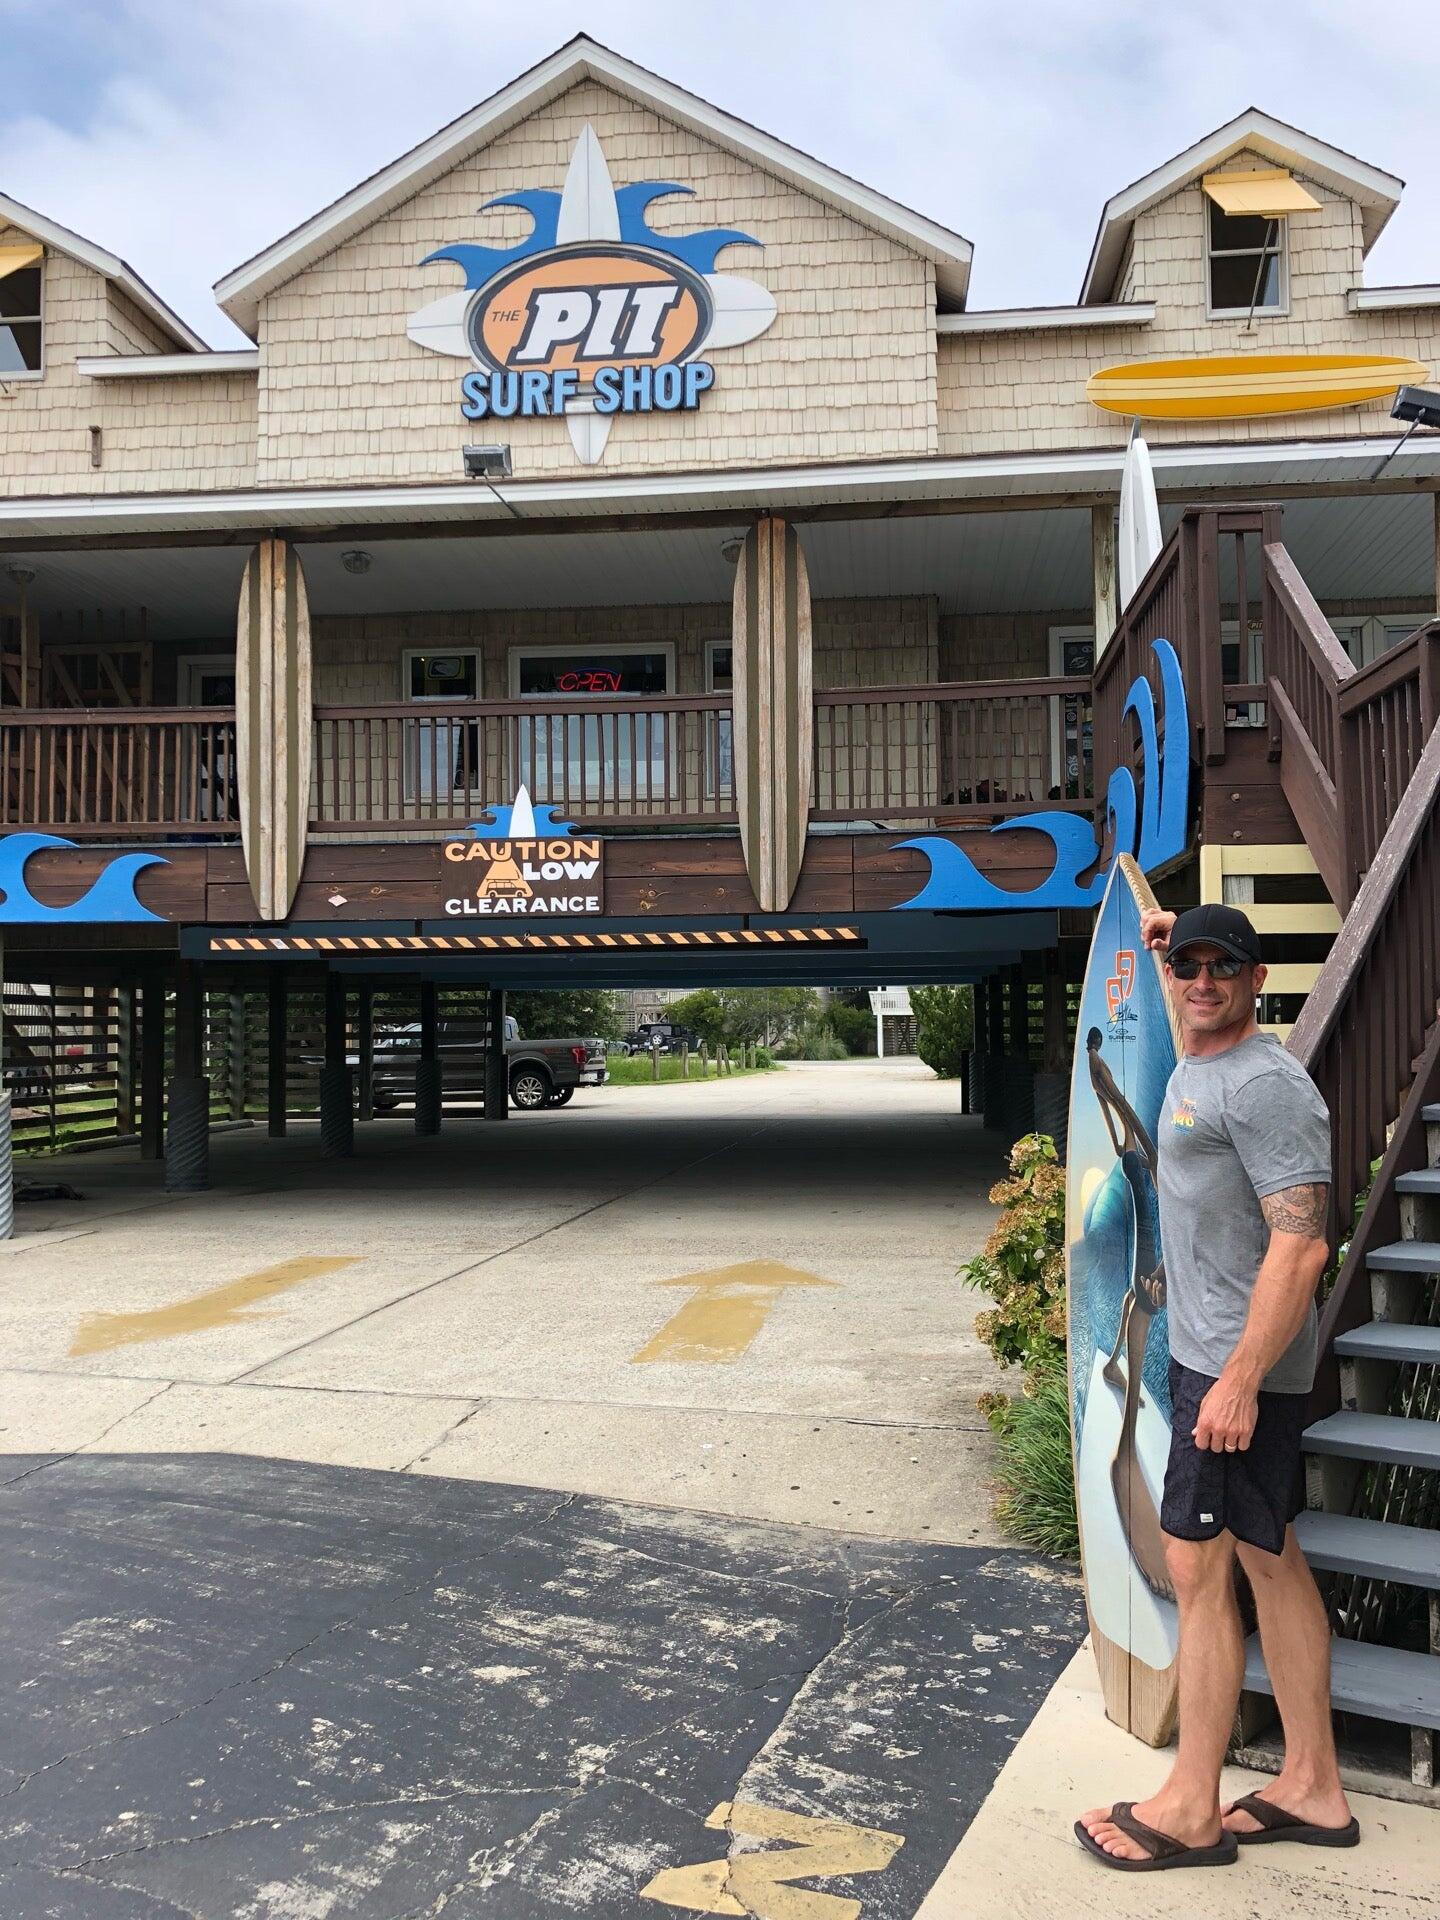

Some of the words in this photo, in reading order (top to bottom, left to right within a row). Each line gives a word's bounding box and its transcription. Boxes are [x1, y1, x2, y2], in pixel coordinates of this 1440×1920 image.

[492, 310, 521, 323] THE
[516, 286, 678, 360] PIT
[461, 370, 580, 420] SURF
[592, 362, 716, 415] SHOP
[559, 673, 622, 692] OPEN
[445, 840, 600, 862] CAUTION
[522, 861, 600, 881] LOW
[444, 896, 600, 915] CLEARANCE
